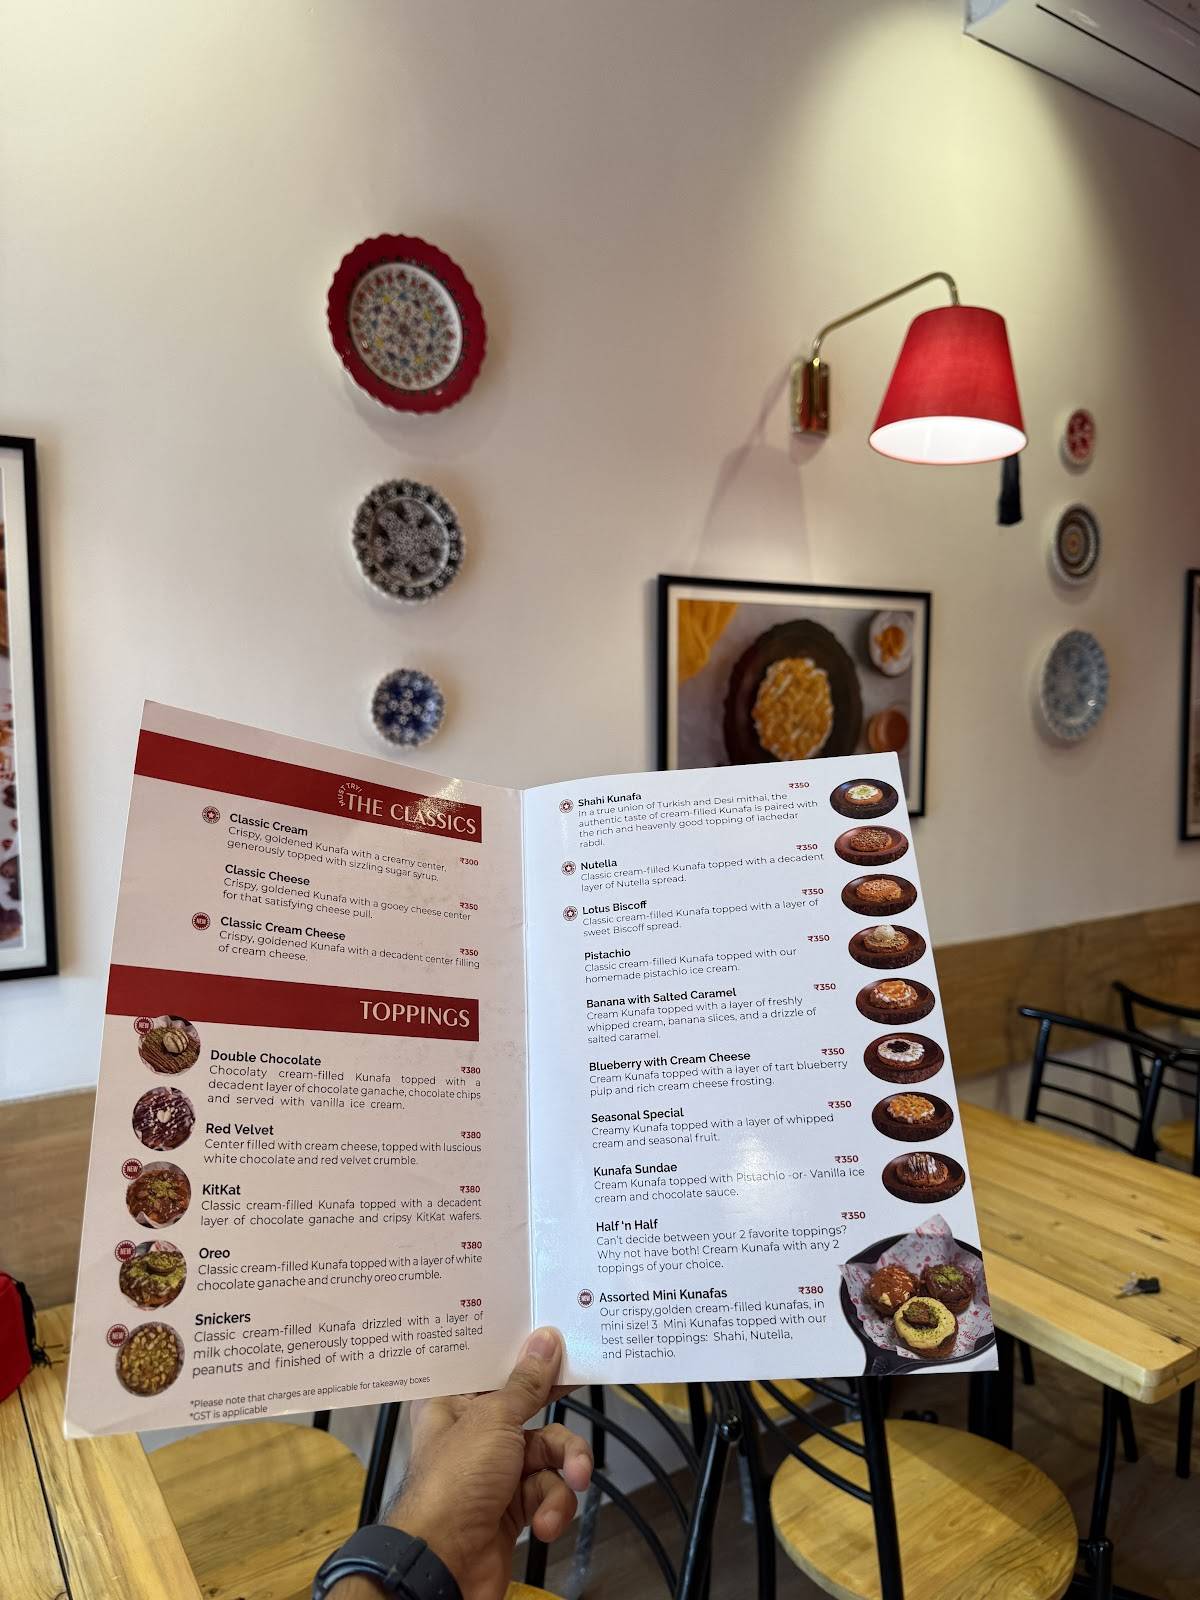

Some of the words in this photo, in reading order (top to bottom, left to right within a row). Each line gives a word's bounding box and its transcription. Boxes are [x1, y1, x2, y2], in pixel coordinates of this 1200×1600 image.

[578, 796, 605, 807] Shahi
[607, 792, 642, 803] Kunafa
[346, 792, 383, 817] THE
[390, 803, 476, 835] CLASSICS
[229, 813, 270, 829] Classic
[272, 821, 308, 836] Cream
[227, 840, 285, 858] generously
[287, 850, 323, 862] topped
[325, 856, 347, 866] with
[349, 859, 383, 874] sizzling
[385, 865, 412, 877] sugar
[581, 859, 618, 870] Nutella
[225, 864, 266, 879] Classic
[268, 871, 310, 886] Cheese
[581, 884, 603, 893] layer
[605, 880, 615, 889] of
[616, 878, 650, 887] Nutella
[223, 889, 238, 900] for
[240, 892, 262, 904] that
[265, 897, 313, 913] satisfying
[316, 903, 351, 916] cheese
[582, 905, 610, 915] Lotus
[613, 900, 647, 912] Biscoff
[220, 916, 262, 931] Classic
[265, 922, 302, 936] Cream
[305, 927, 346, 941] Cheese
[584, 948, 631, 961] Pistachio
[585, 971, 641, 983] homemade
[643, 967, 688, 980] pistachio
[689, 966, 704, 974] ice
[586, 998, 626, 1008] Banana
[627, 994, 651, 1005] with
[653, 991, 688, 1003] Salted
[690, 987, 737, 1000] Caramel
[360, 1000, 470, 1028] TOPPINGS
[211, 1050, 257, 1063] Double
[260, 1053, 321, 1066] Chocolate
[589, 1060, 642, 1072] Blueberry
[643, 1057, 668, 1067] with
[670, 1056, 706, 1065] Cream
[708, 1052, 751, 1063] Cheese
[209, 1065, 268, 1080] Chocolaty
[278, 1070, 344, 1081] cream-filled
[355, 1073, 391, 1083] Kunafa
[401, 1075, 436, 1086] topped
[445, 1078, 466, 1086] with
[591, 1110, 641, 1123] Seasonal
[643, 1107, 684, 1122] Special
[206, 1123, 231, 1134] Red
[234, 1123, 274, 1136] Velvet
[594, 1165, 632, 1177] Kunafa
[635, 1163, 677, 1174] Sundae
[202, 1184, 241, 1195] KitKat
[201, 1200, 241, 1211] Classic
[246, 1199, 313, 1211] cream-filled
[318, 1199, 355, 1210] Kunafa
[360, 1200, 396, 1211] topped
[400, 1198, 423, 1208] with
[427, 1200, 433, 1208] a
[437, 1198, 482, 1208] decadent
[201, 1215, 229, 1228] layer
[233, 1214, 246, 1225] of
[250, 1214, 304, 1225] chocolate
[308, 1213, 355, 1227] ganache
[359, 1213, 379, 1223] and
[383, 1212, 412, 1224] cripsy
[416, 1211, 445, 1222] KitKat
[596, 1220, 620, 1232] Half
[634, 1218, 658, 1230] Half
[596, 1235, 623, 1246] Can't
[625, 1233, 661, 1245] decide
[663, 1233, 710, 1243] between
[712, 1232, 737, 1243] your
[739, 1229, 746, 1239] 2
[748, 1227, 789, 1239] favorite
[792, 1225, 847, 1238] toppings?
[199, 1247, 230, 1259] Oreo
[598, 1262, 644, 1275] toppings
[646, 1260, 657, 1271] of
[659, 1262, 683, 1273] your
[685, 1258, 724, 1269] choice.
[599, 1290, 650, 1303] Assorted
[653, 1289, 677, 1301] Mini
[679, 1287, 728, 1300] Kunafas
[194, 1329, 236, 1343] Classic
[242, 1323, 312, 1339] cream-filled
[318, 1320, 356, 1333] Kunafa
[362, 1316, 402, 1330] drizzled
[407, 1315, 429, 1326] with
[435, 1316, 441, 1324] a
[446, 1313, 468, 1325] layer
[473, 1310, 484, 1321] of
[195, 1312, 251, 1326] Snickers
[193, 1346, 221, 1359] milk
[223, 1342, 284, 1357] chocolate,
[287, 1336, 348, 1354] generously
[350, 1332, 389, 1347] topped
[391, 1330, 414, 1342] with
[416, 1326, 453, 1340] roasted
[454, 1325, 483, 1337] salted
[601, 1335, 624, 1345] best
[626, 1334, 654, 1344] seller
[656, 1332, 708, 1345] toppings:
[192, 1362, 243, 1379] peanuts
[247, 1358, 270, 1371] and
[275, 1353, 321, 1368] finished
[325, 1351, 337, 1364] of
[340, 1350, 364, 1362] with
[368, 1351, 375, 1360] a
[378, 1346, 412, 1358] drizzle
[415, 1344, 426, 1355] of
[225, 1396, 246, 1405] note
[247, 1394, 266, 1403] that
[267, 1390, 301, 1400] charges
[317, 1383, 358, 1396] applicable
[359, 1381, 371, 1390] for
[372, 1379, 408, 1389] takeaway
[409, 1376, 430, 1384] boxes
[213, 1409, 221, 1418] is
[222, 1404, 268, 1418] applicable
